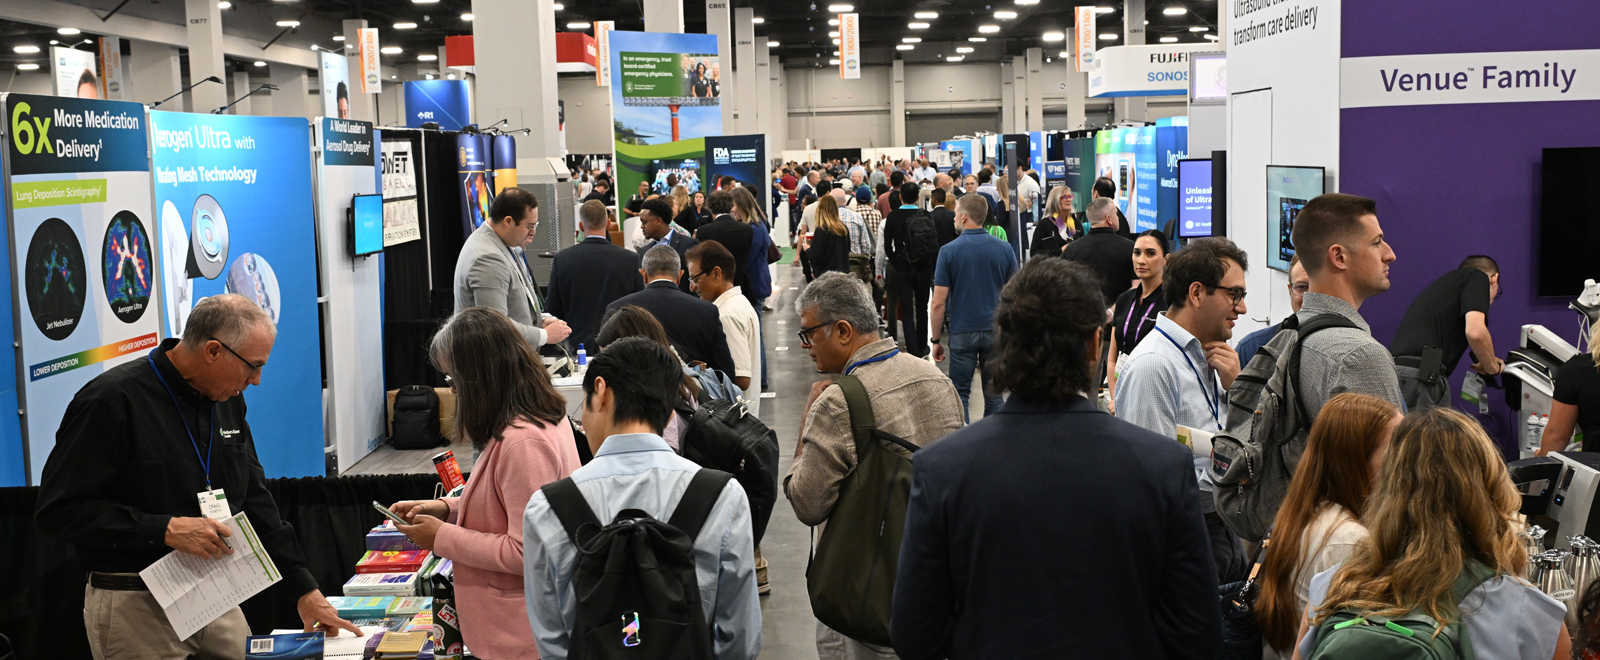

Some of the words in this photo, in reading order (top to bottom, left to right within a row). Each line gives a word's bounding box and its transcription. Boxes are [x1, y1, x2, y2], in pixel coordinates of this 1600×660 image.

[1084, 10, 1092, 48] 1700/1800
[1234, 20, 1266, 46] transform
[1268, 18, 1282, 36] care
[1284, 6, 1318, 30] delivery
[846, 16, 854, 56] 1900/2000
[366, 31, 376, 70] 2300/2400
[1482, 62, 1576, 93] Family
[12, 102, 54, 155] 6x
[54, 108, 82, 128] More
[84, 110, 139, 130] Medication
[330, 120, 334, 132] A
[334, 120, 346, 133] World
[347, 122, 360, 134] Leader
[361, 125, 366, 134] in
[194, 125, 231, 149] Ultra
[234, 136, 256, 149] with
[326, 139, 342, 152] Aerosol
[342, 140, 354, 155] Drug
[714, 148, 729, 157] FDA
[177, 166, 198, 182] Mesh
[198, 166, 257, 184] Technology
[16, 190, 32, 202] Lung
[33, 188, 65, 201] Deposition
[118, 305, 133, 314] Aerogen
[53, 318, 74, 328] Nebulizer
[118, 342, 134, 352] HIGHER
[134, 337, 156, 348] DEPOSITION
[34, 366, 51, 377] LOWER
[51, 358, 79, 372] DEPOSITION
